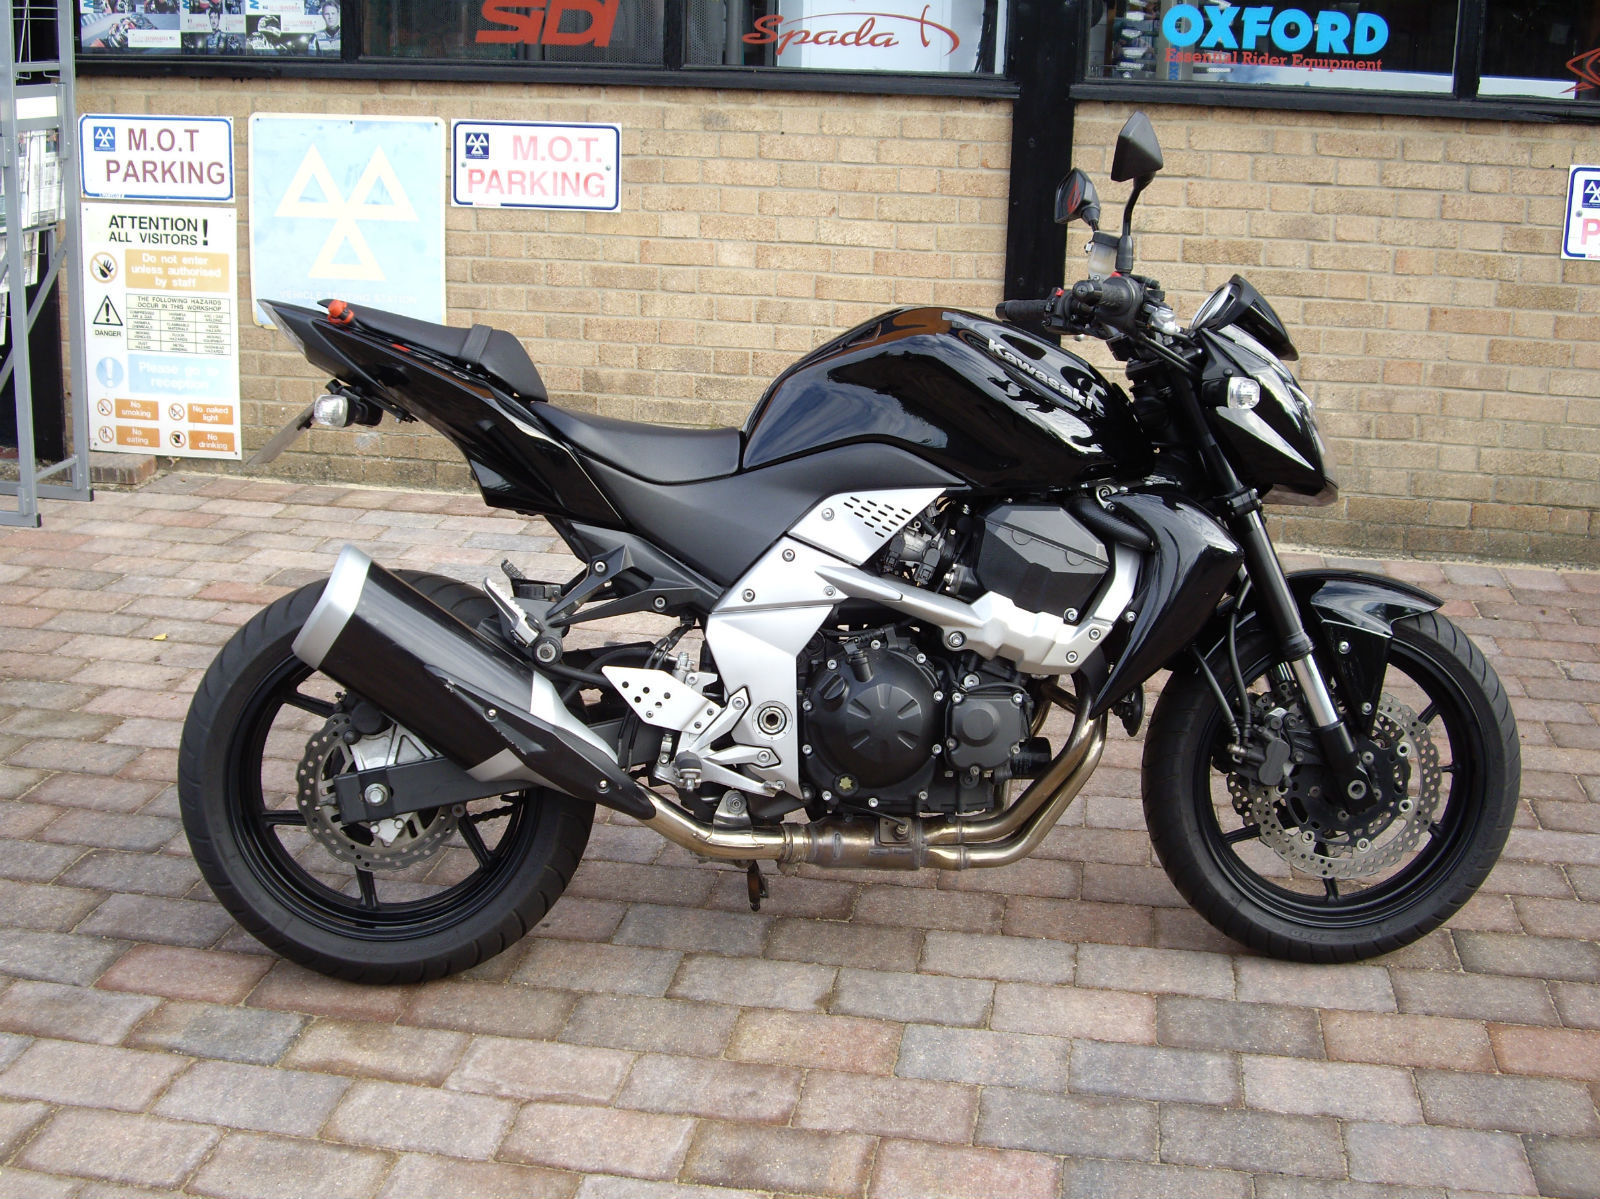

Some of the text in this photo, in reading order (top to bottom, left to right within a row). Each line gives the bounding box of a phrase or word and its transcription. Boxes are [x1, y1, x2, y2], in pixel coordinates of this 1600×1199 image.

[741, 14, 900, 56] Spada
[1162, 3, 1389, 55] OXFORD
[1164, 47, 1238, 64] Essential
[1242, 53, 1288, 67] Rider
[1291, 54, 1382, 72] Equipment
[128, 127, 199, 152] M.O.T
[512, 135, 602, 163] M.O.T.
[106, 159, 225, 185] PARKING
[467, 168, 606, 198] PARKING
[108, 215, 198, 232] ATTENTION
[109, 231, 198, 246] ALL VISITORS
[142, 253, 208, 266] Do not enter
[131, 264, 221, 278] unless authorised
[154, 276, 197, 288] by staff
[152, 296, 188, 304] FOLLOWING
[191, 298, 222, 306] HAZARDS
[187, 304, 222, 312] WORKSHOP
[95, 329, 122, 337] DANGER
[988, 338, 1094, 410] Kawasaki
[130, 401, 141, 409] No
[206, 406, 229, 415] naked
[121, 408, 151, 418] smoking
[203, 413, 218, 423] light
[126, 435, 149, 445] eating
[207, 433, 218, 441] No
[198, 440, 228, 450] drinking
